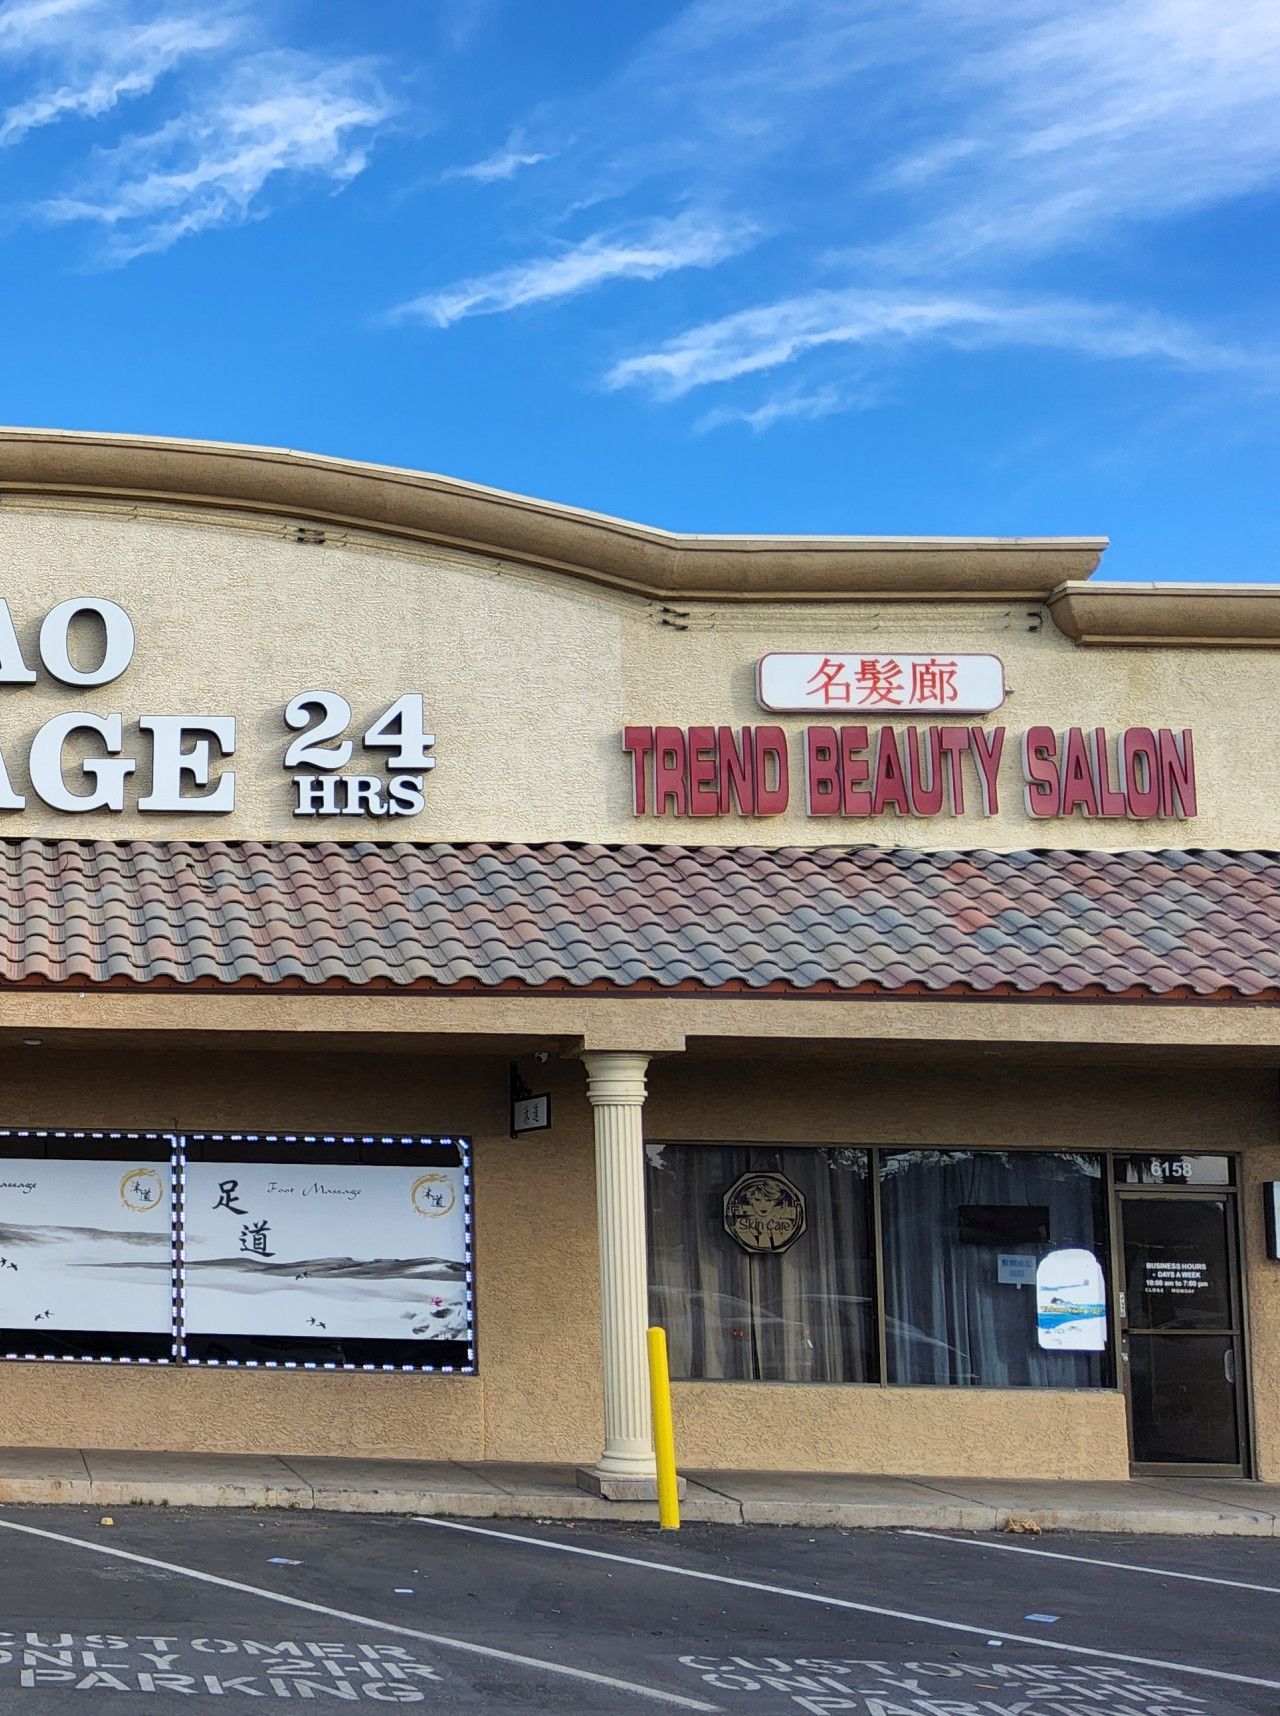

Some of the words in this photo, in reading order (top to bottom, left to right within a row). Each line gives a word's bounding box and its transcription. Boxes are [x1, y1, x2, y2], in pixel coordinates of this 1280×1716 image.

[806, 657, 958, 705] 名髮廊
[284, 689, 436, 771] 24
[623, 726, 789, 817] TREND
[803, 726, 1005, 818] BEAUTY
[1023, 726, 1198, 820] SALON
[292, 774, 424, 817] HRS
[1150, 1161, 1192, 1177] 6158
[267, 1182, 294, 1193] Foot
[302, 1183, 362, 1200] Massage
[211, 1180, 276, 1257] 足道
[739, 1218, 763, 1230] Skin
[1146, 1262, 1180, 1270] BUSINESS
[265, 1658, 443, 1682] 2HR
[678, 1655, 1150, 1683] CUSTOMER
[19, 1668, 425, 1702] PARKING
[701, 1673, 932, 1696] ONLY
[1003, 1681, 1209, 1703] 2HR
